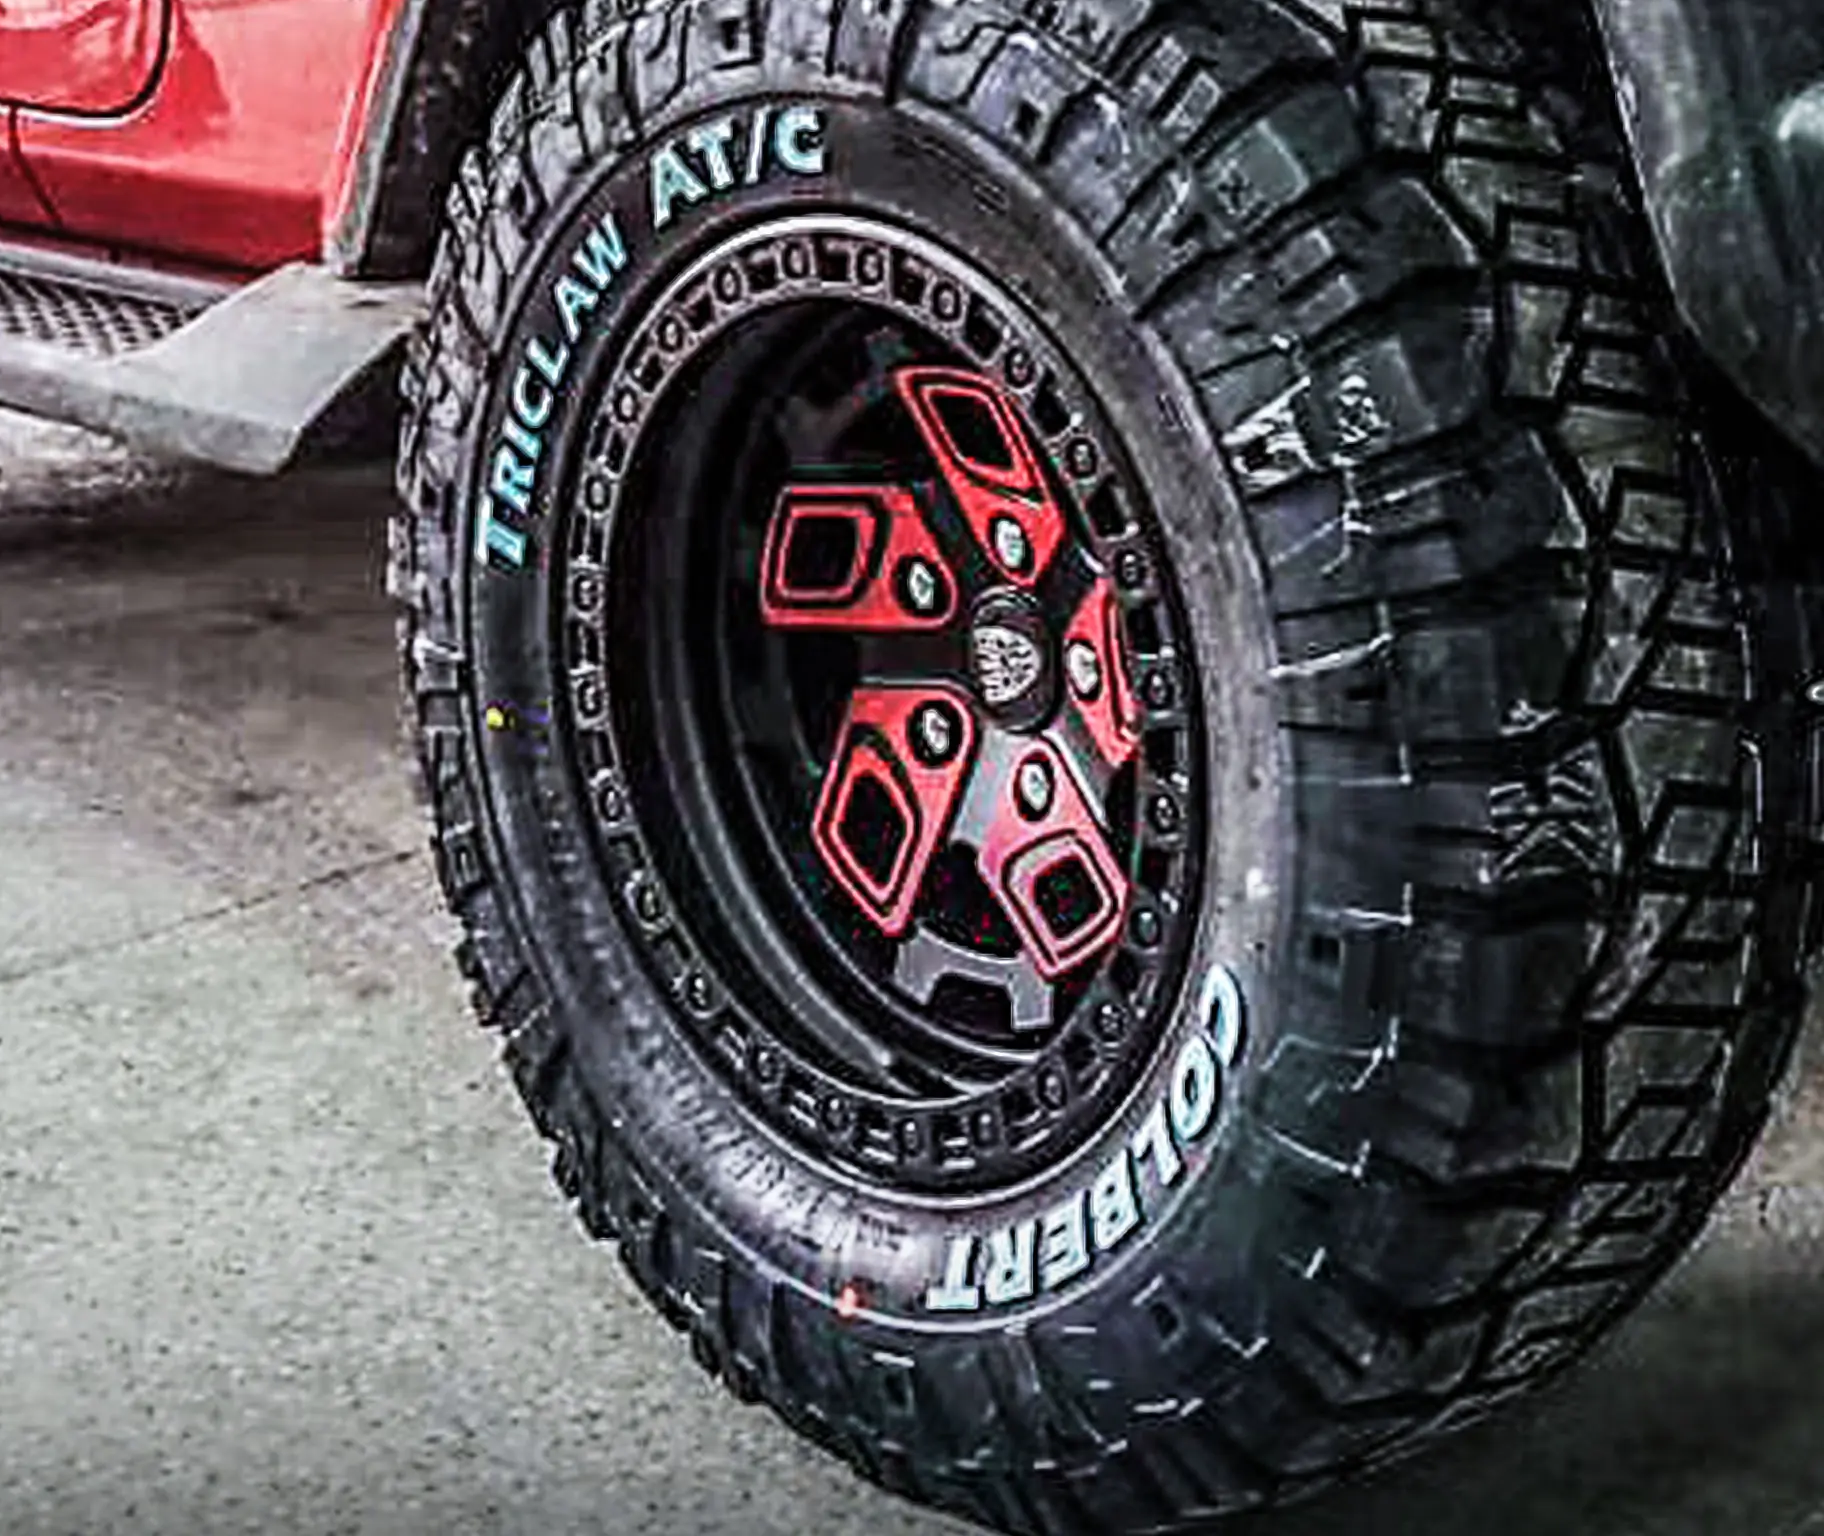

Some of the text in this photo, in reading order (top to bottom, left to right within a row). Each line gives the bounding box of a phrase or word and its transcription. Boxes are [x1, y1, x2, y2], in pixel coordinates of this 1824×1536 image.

[477, 106, 826, 568] TRICLAW AT/C
[925, 966, 1246, 1310] COLBERT
